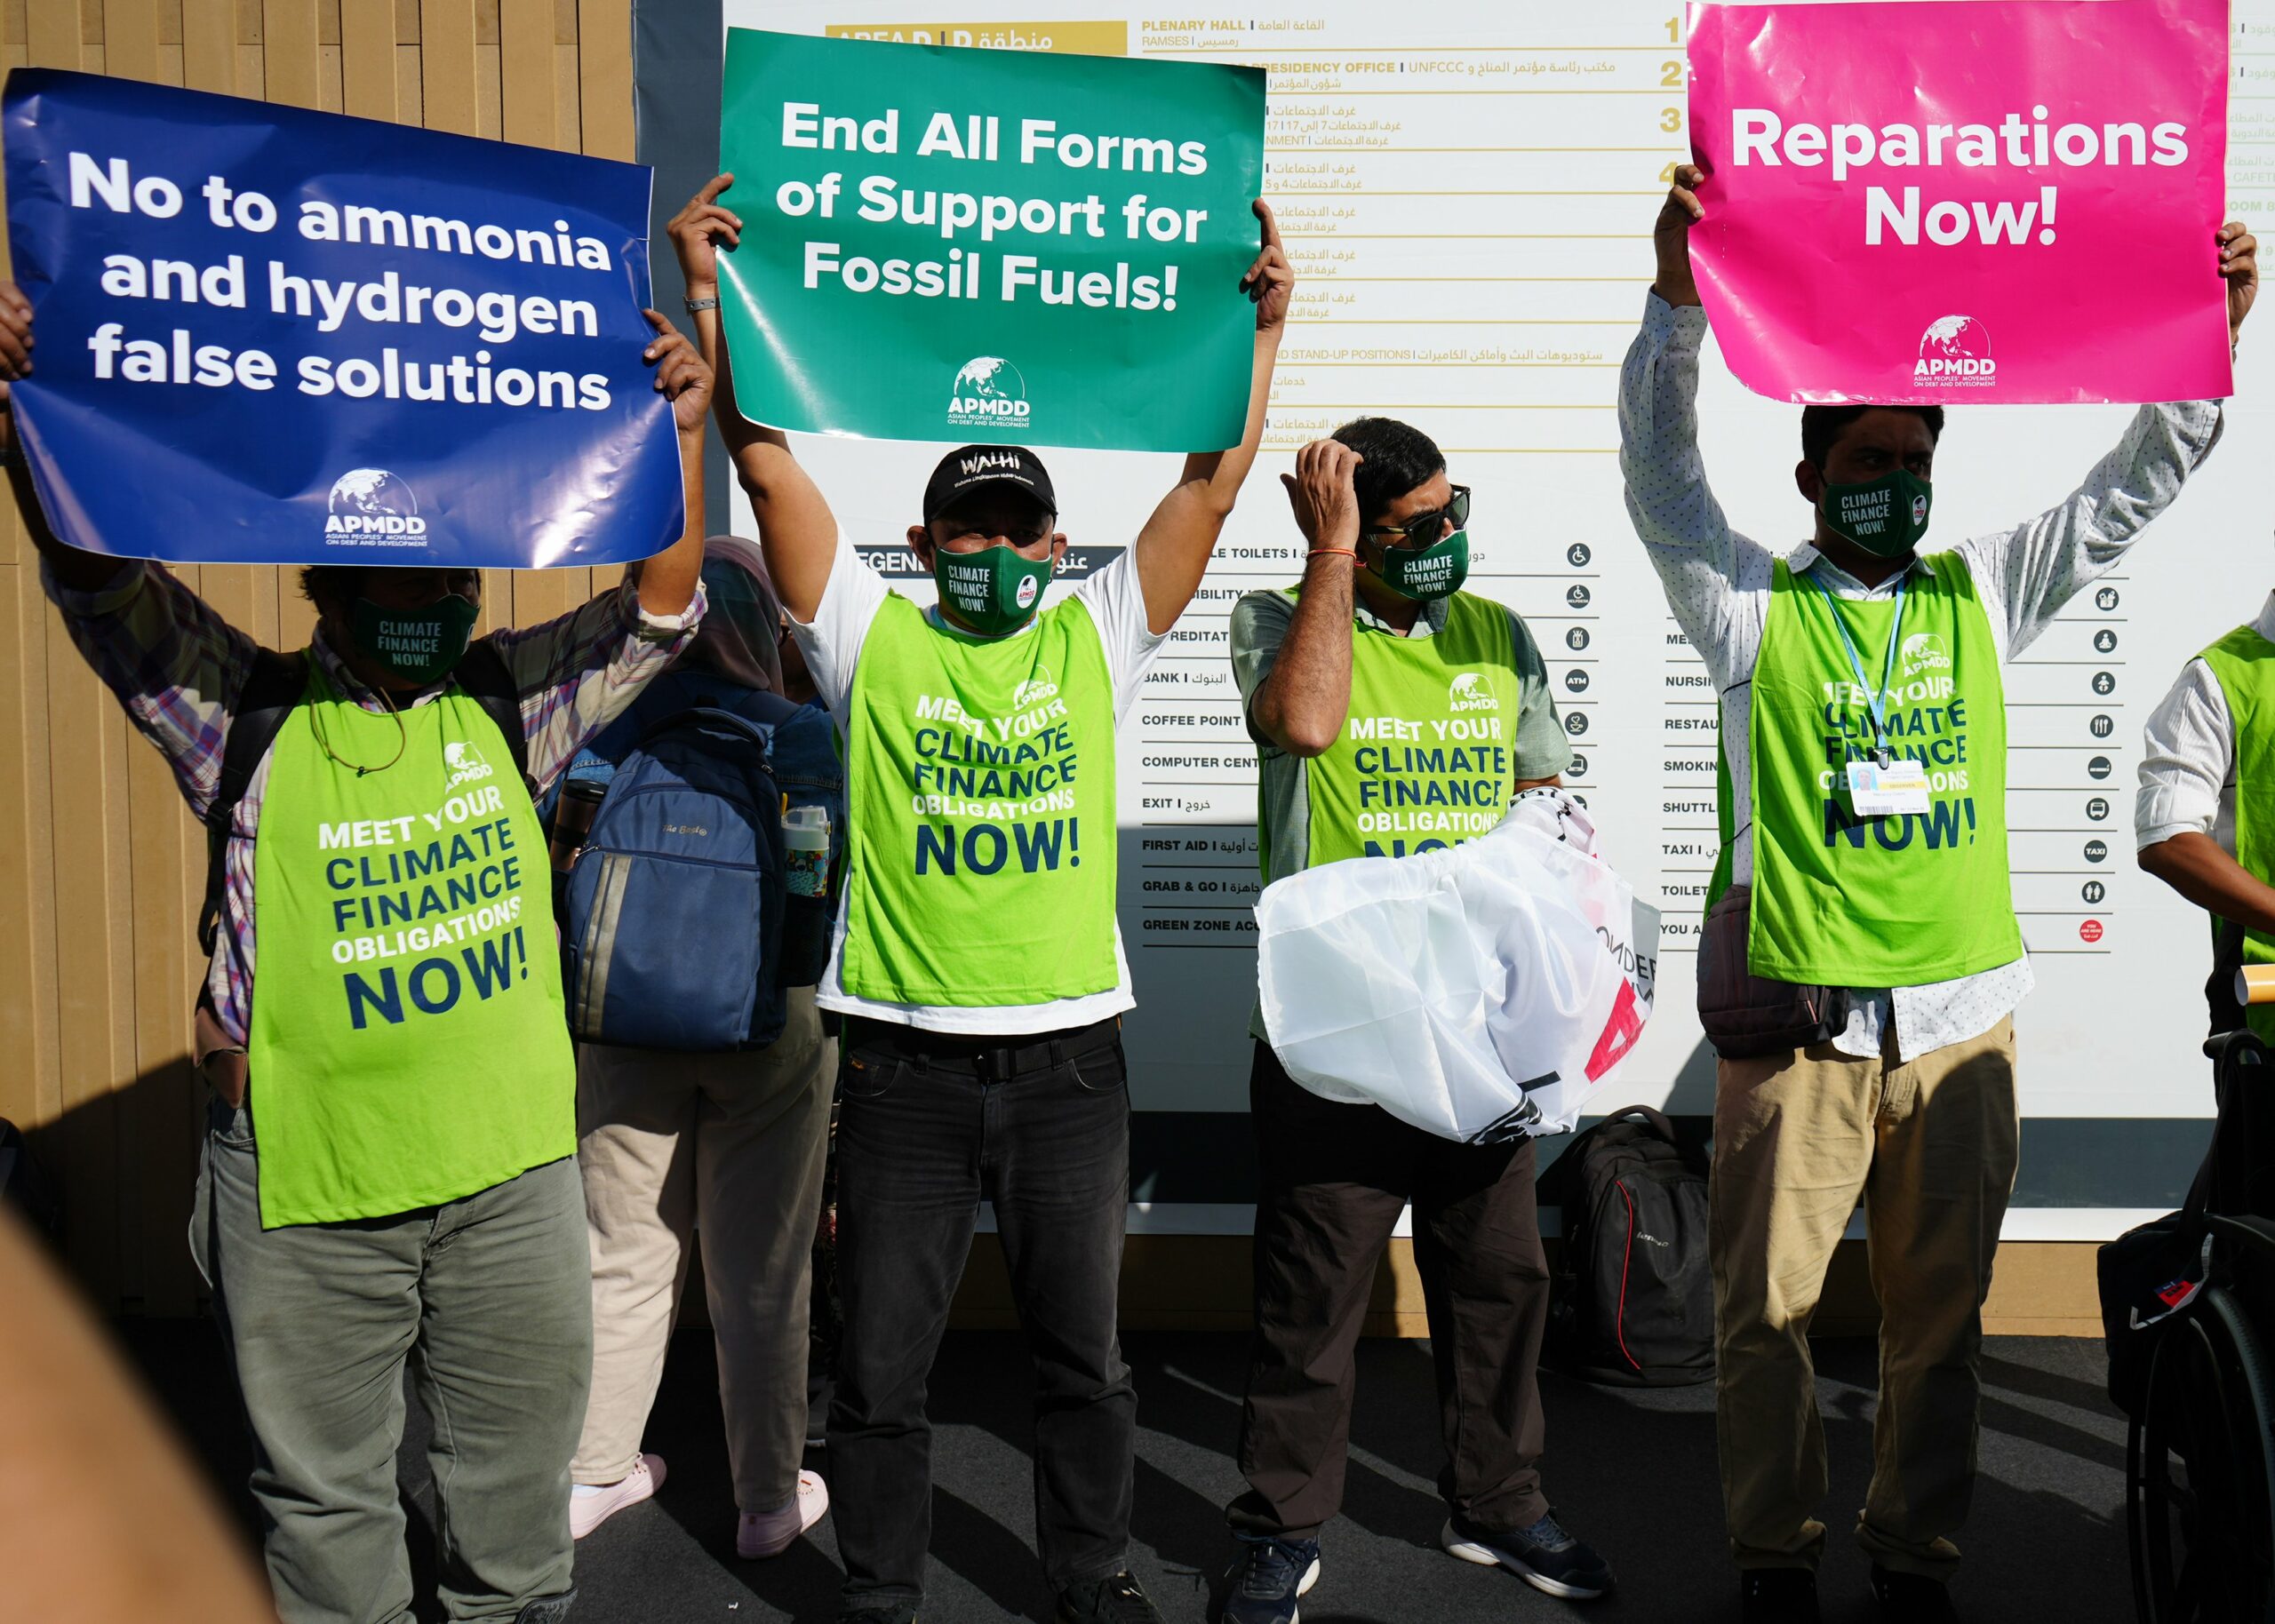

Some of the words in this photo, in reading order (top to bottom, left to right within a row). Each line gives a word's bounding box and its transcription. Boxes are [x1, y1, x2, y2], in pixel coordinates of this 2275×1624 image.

[1142, 20, 1205, 31] PLENARY
[1210, 20, 1245, 30] HALL
[1258, 20, 1290, 31] العامة
[1293, 20, 1324, 31] القاعة
[1664, 17, 1679, 43] 1
[1142, 36, 1189, 46] RAMSES
[1345, 62, 1395, 73] OFFICE
[1409, 61, 1465, 73] UNFCCC
[1478, 61, 1509, 77] المناخ
[1513, 61, 1545, 76] مؤتمر
[1550, 61, 1580, 75] رئاسة
[1585, 61, 1616, 75] مكتب
[1660, 60, 1682, 86] 2
[1273, 105, 1329, 117] الاجتماعات
[1332, 106, 1356, 117] غرف
[1660, 107, 1680, 132] 3
[782, 100, 899, 155] End
[916, 111, 999, 162] All
[1020, 118, 1208, 176] Forms
[1731, 105, 2189, 181] Reparations
[1273, 163, 1329, 175] الاجتماعات
[1332, 163, 1356, 175] غرف
[68, 151, 182, 219] No
[203, 176, 277, 233] to
[299, 200, 612, 271] ammonia
[776, 171, 842, 218] of
[858, 175, 1106, 243] Support
[1122, 195, 1208, 243] for
[1332, 207, 1356, 219] غرف
[1865, 186, 2057, 247] Now!
[1332, 250, 1356, 261] غرف
[803, 241, 979, 299] Fossil
[1001, 254, 1178, 312] Fuels!
[100, 253, 246, 308] and
[268, 260, 598, 344] hydrogen
[1332, 292, 1356, 304] غرف
[1291, 349, 1348, 359] STAND-UP
[1351, 349, 1410, 359] POSITIONS
[87, 322, 277, 392] false
[298, 347, 611, 411] solutions
[1913, 359, 1996, 375] APMDD
[947, 397, 1030, 417] APMDD
[961, 451, 1020, 474] WALHI
[1841, 490, 1891, 509] CLIMATE
[1841, 504, 1890, 523] FINANCE
[324, 515, 427, 534] APMDD
[1855, 520, 1886, 536] NOW!
[1232, 548, 1288, 559] TOILETS
[1404, 554, 1453, 573] CLIMATE
[947, 565, 990, 583] CLIMATE
[1403, 569, 1452, 585] FINANCE
[949, 579, 989, 598] FINANCE
[1416, 581, 1446, 593] NOW!
[959, 596, 986, 612] NOW!
[379, 620, 442, 637] CLIMATE
[378, 636, 439, 653] FINANCE
[392, 653, 430, 666] NOW!
[1904, 656, 1951, 678] APMDD
[1192, 673, 1226, 686] البنوك
[1449, 697, 1498, 712] APMDD
[915, 695, 986, 739] MEET
[993, 697, 1068, 742] YOUR
[1142, 715, 1194, 725] COFFEE
[1201, 716, 1241, 726] POINT
[1350, 717, 1423, 742] MEET
[1430, 717, 1502, 741] YOUR
[914, 721, 1074, 765] CLIMATE
[1142, 757, 1218, 767] COMPUTER
[1354, 745, 1506, 775] CLIMATE
[445, 763, 493, 795] APMDD
[914, 754, 1077, 799] FINANCE
[1360, 779, 1503, 808] FINANCE
[912, 789, 1074, 820] OBLIGATIONS
[1143, 799, 1172, 808] EXIT
[1185, 800, 1210, 812] خروج
[319, 816, 416, 849] MEET
[423, 785, 505, 832] YOUR
[1357, 812, 1498, 832] OBLIGATIONS
[1824, 797, 1976, 851] NOW!
[326, 816, 515, 889] CLIMATE
[914, 817, 1080, 876] NOW!
[1143, 840, 1181, 850] FIRST
[1185, 841, 1208, 851] AID
[1662, 846, 1693, 855] TAXI
[332, 856, 522, 933] FINANCE
[1143, 881, 1180, 891] GRAB
[1185, 882, 1193, 891] &
[1198, 882, 1217, 892] GO
[331, 896, 522, 964] OBLIGATIONS
[1143, 920, 1189, 930] GREEN
[1193, 921, 1230, 930] ZONE
[1660, 925, 1688, 935] YOU
[342, 926, 528, 1030] NOW!
